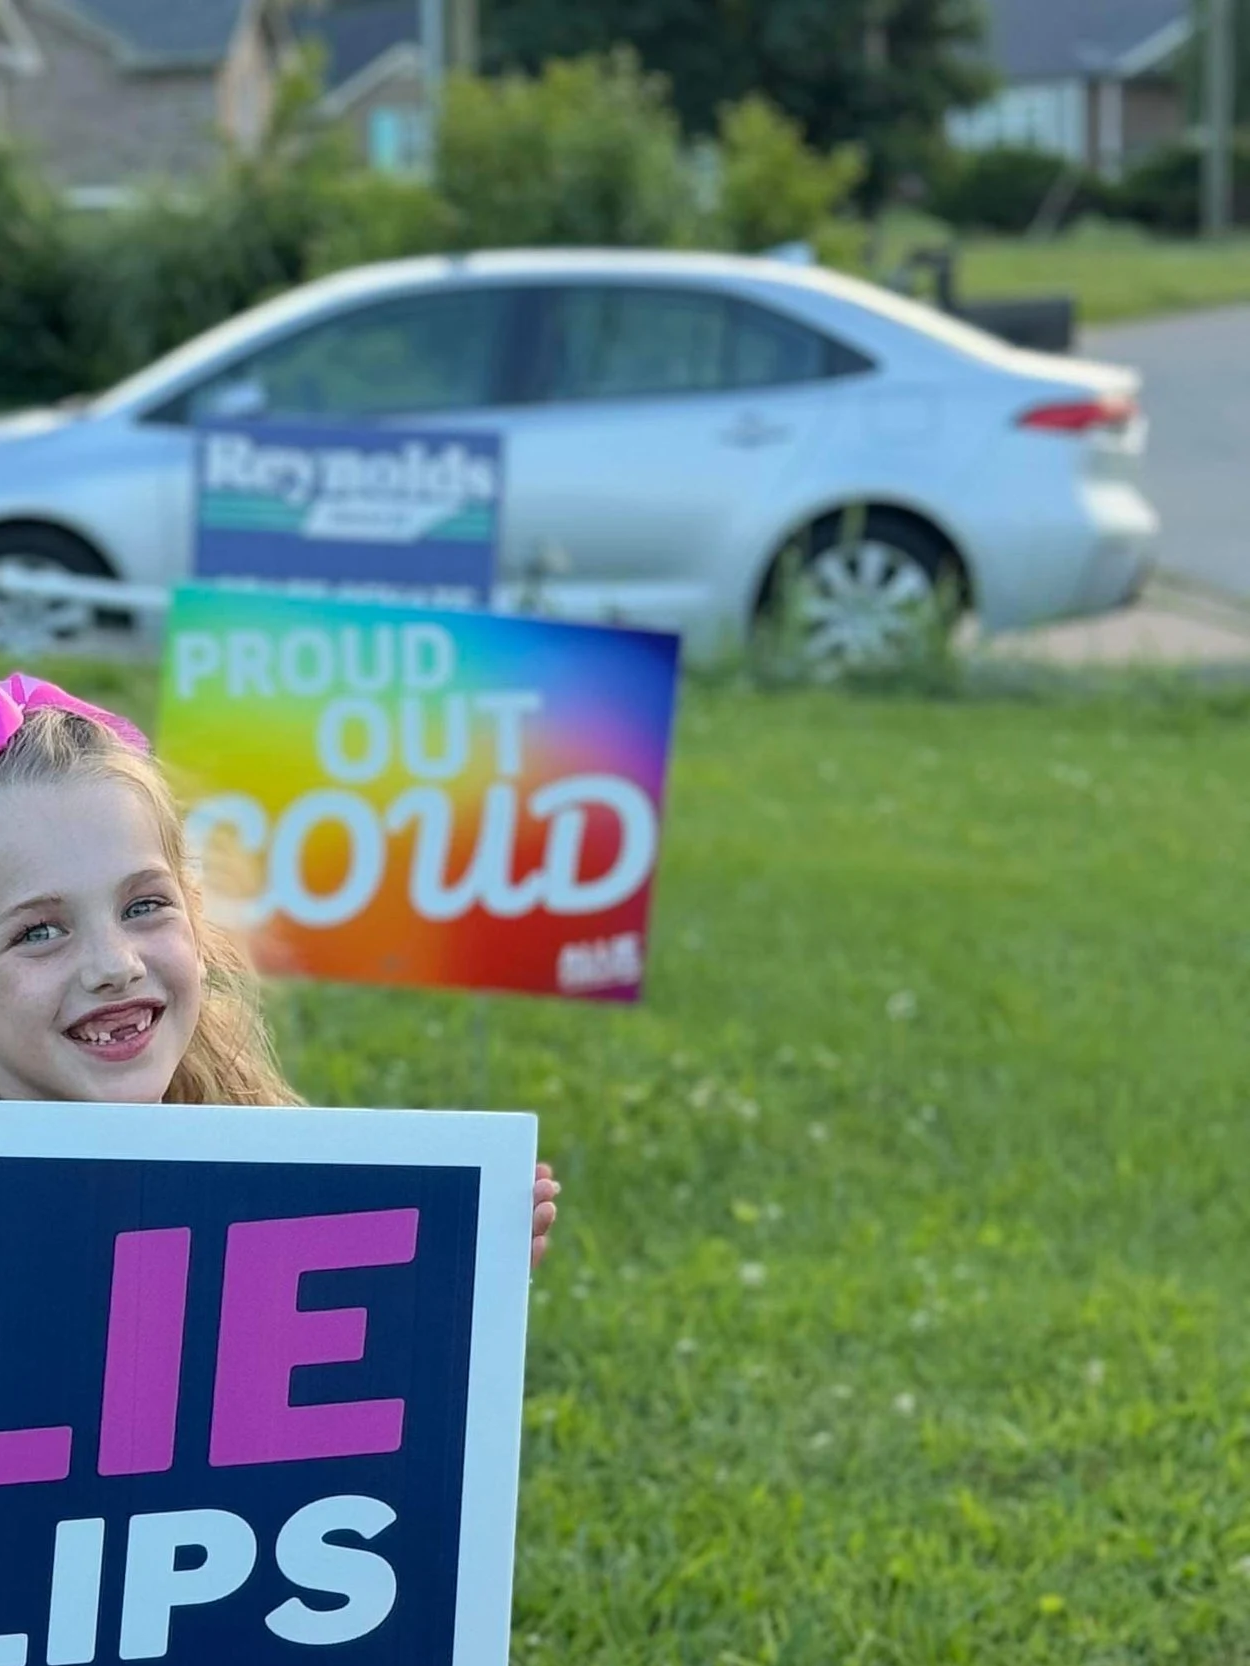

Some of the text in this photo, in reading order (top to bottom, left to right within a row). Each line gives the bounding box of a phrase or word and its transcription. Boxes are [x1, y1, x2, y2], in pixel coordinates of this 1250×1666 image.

[205, 434, 495, 505] Reynolds
[173, 622, 454, 698] PROUD
[316, 688, 542, 783] OUT
